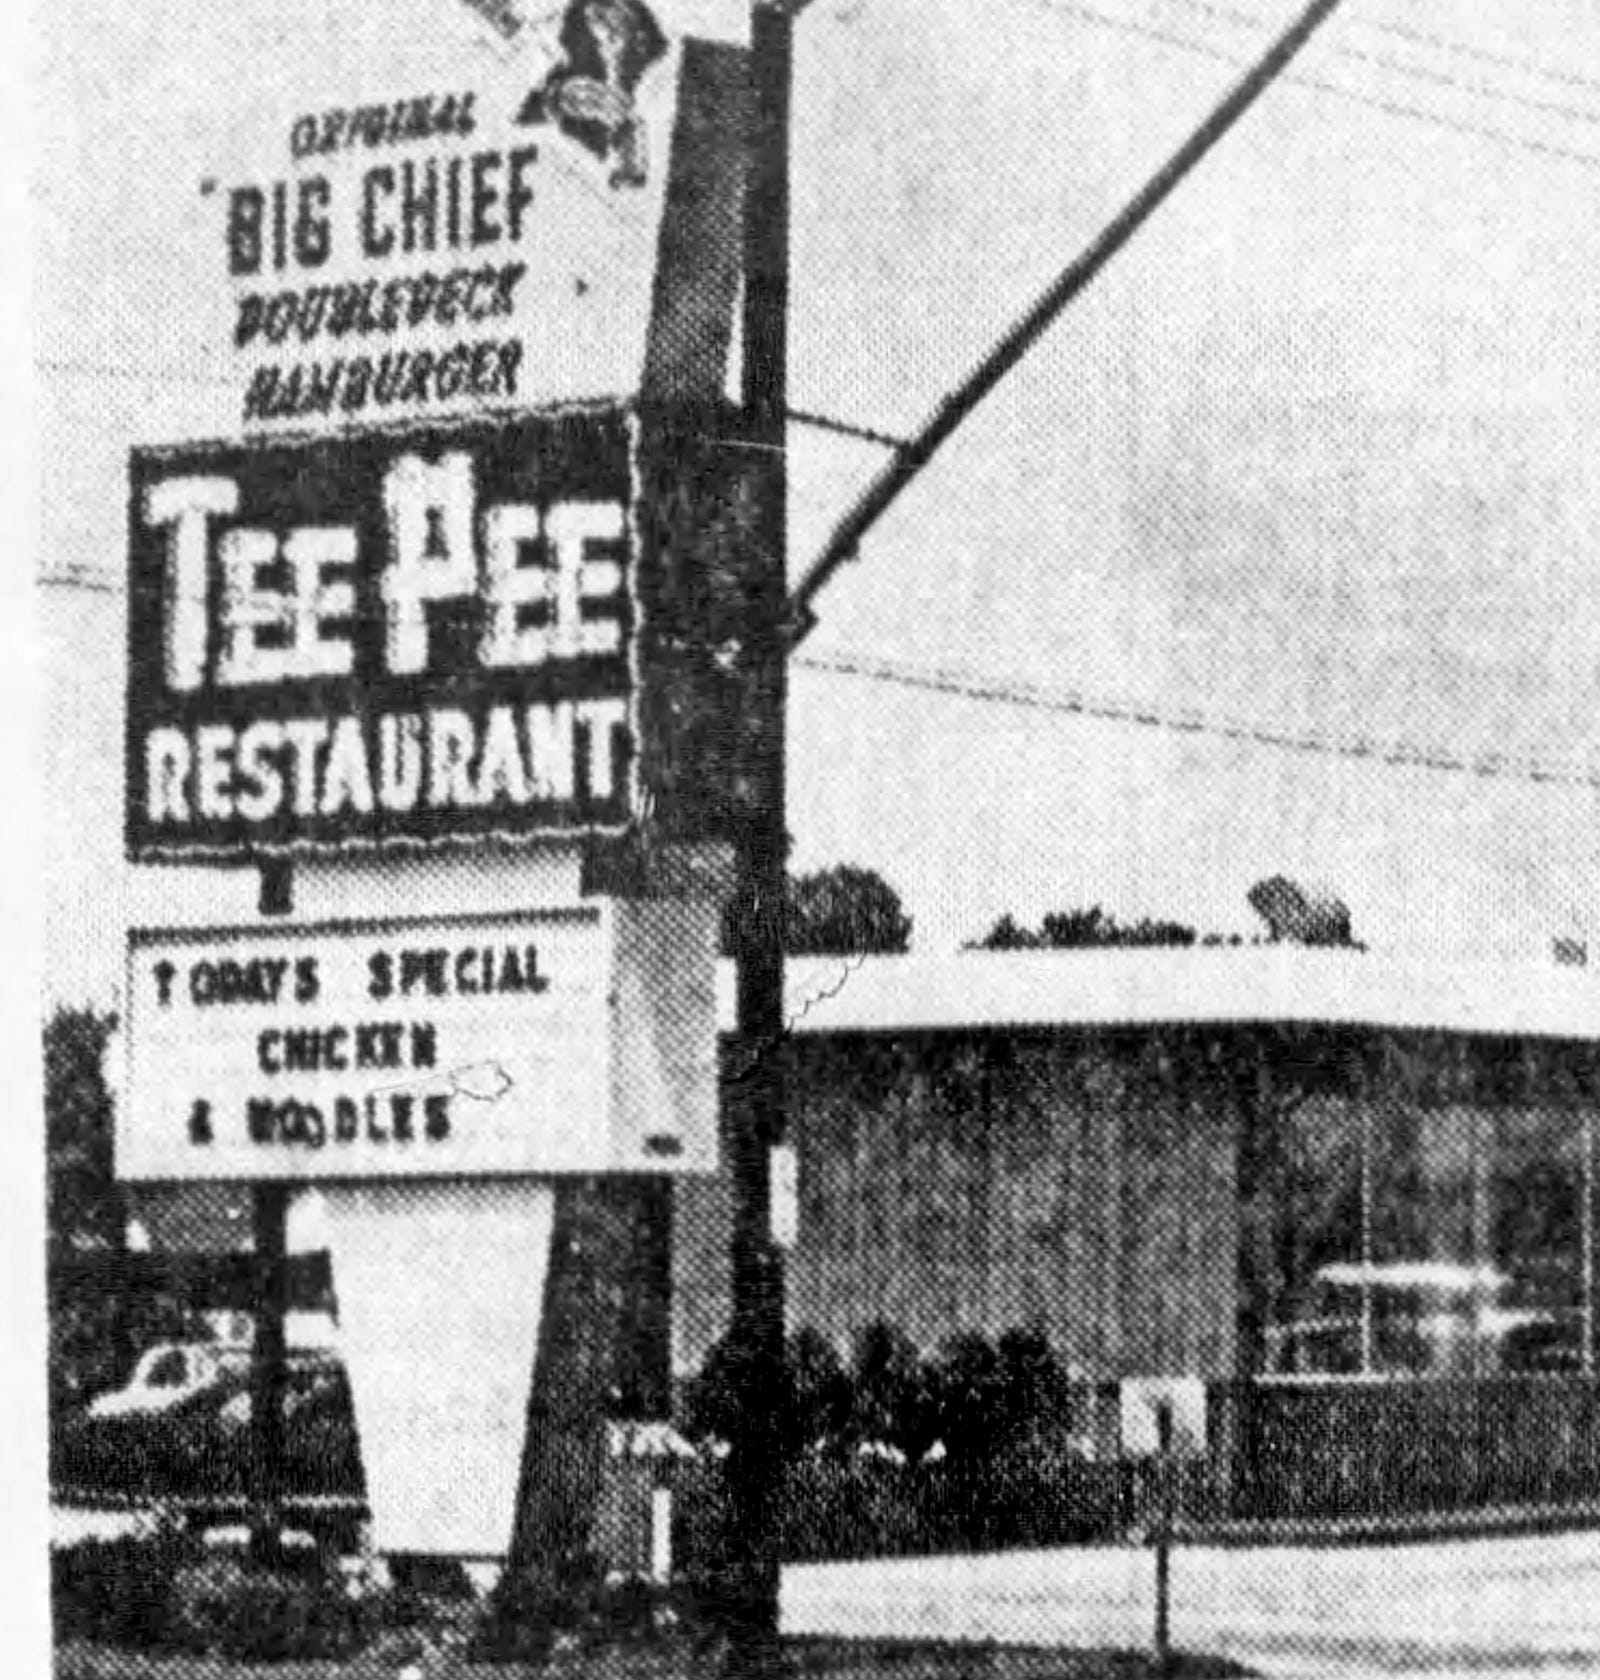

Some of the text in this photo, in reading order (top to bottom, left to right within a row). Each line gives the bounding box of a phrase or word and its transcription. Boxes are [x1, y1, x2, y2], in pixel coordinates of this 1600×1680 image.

[226, 144, 539, 276] BIG CHIEF
[233, 262, 528, 348] DOUBLEDECK
[241, 338, 524, 422] HAMBURGER
[141, 450, 625, 692] TEE PEE
[146, 698, 626, 822] RESTAURANT
[367, 944, 550, 1001] SPECIAL
[257, 1021, 438, 1074] CHICKEN
[245, 1094, 453, 1150] NOODLES
